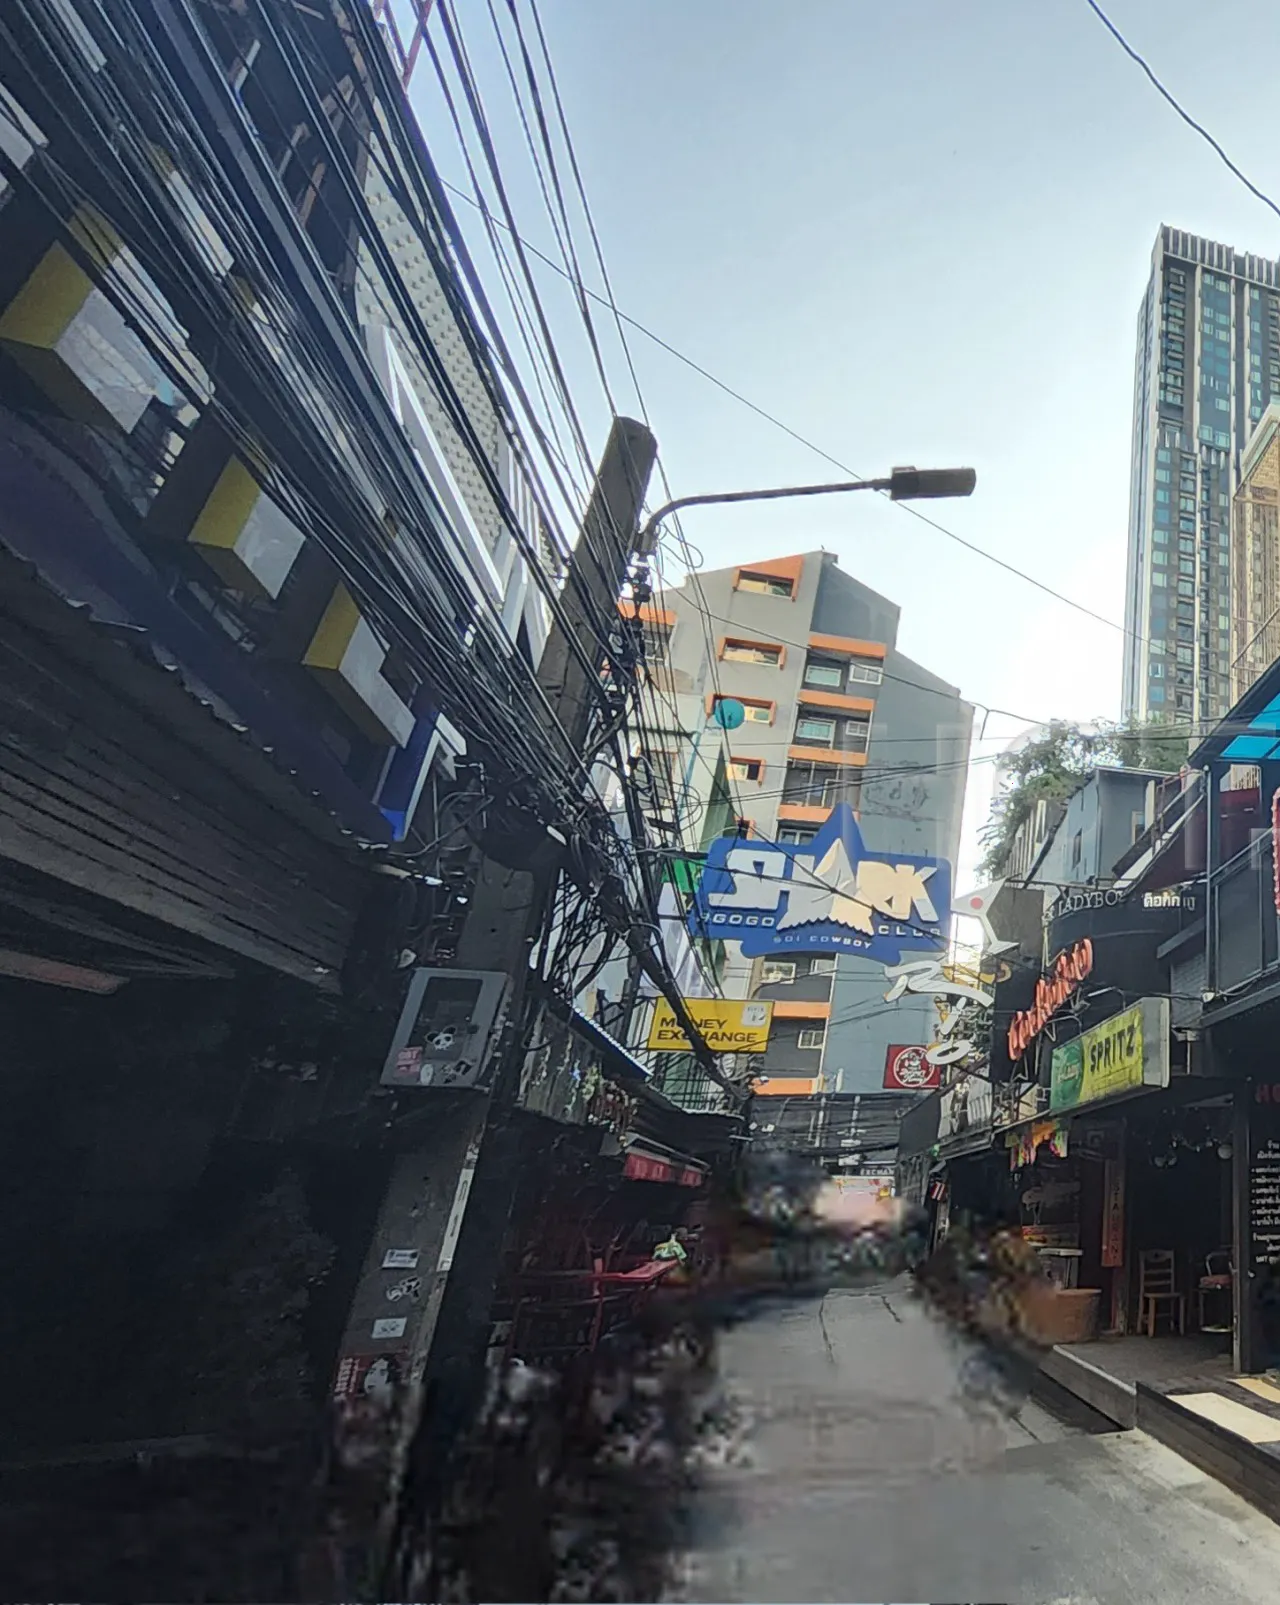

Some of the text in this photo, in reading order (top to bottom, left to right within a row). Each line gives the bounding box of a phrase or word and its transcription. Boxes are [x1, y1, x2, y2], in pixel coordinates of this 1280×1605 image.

[708, 838, 940, 936] SHARK
[809, 935, 874, 949] COWBOY
[1089, 1025, 1137, 1073] SPRITZ
